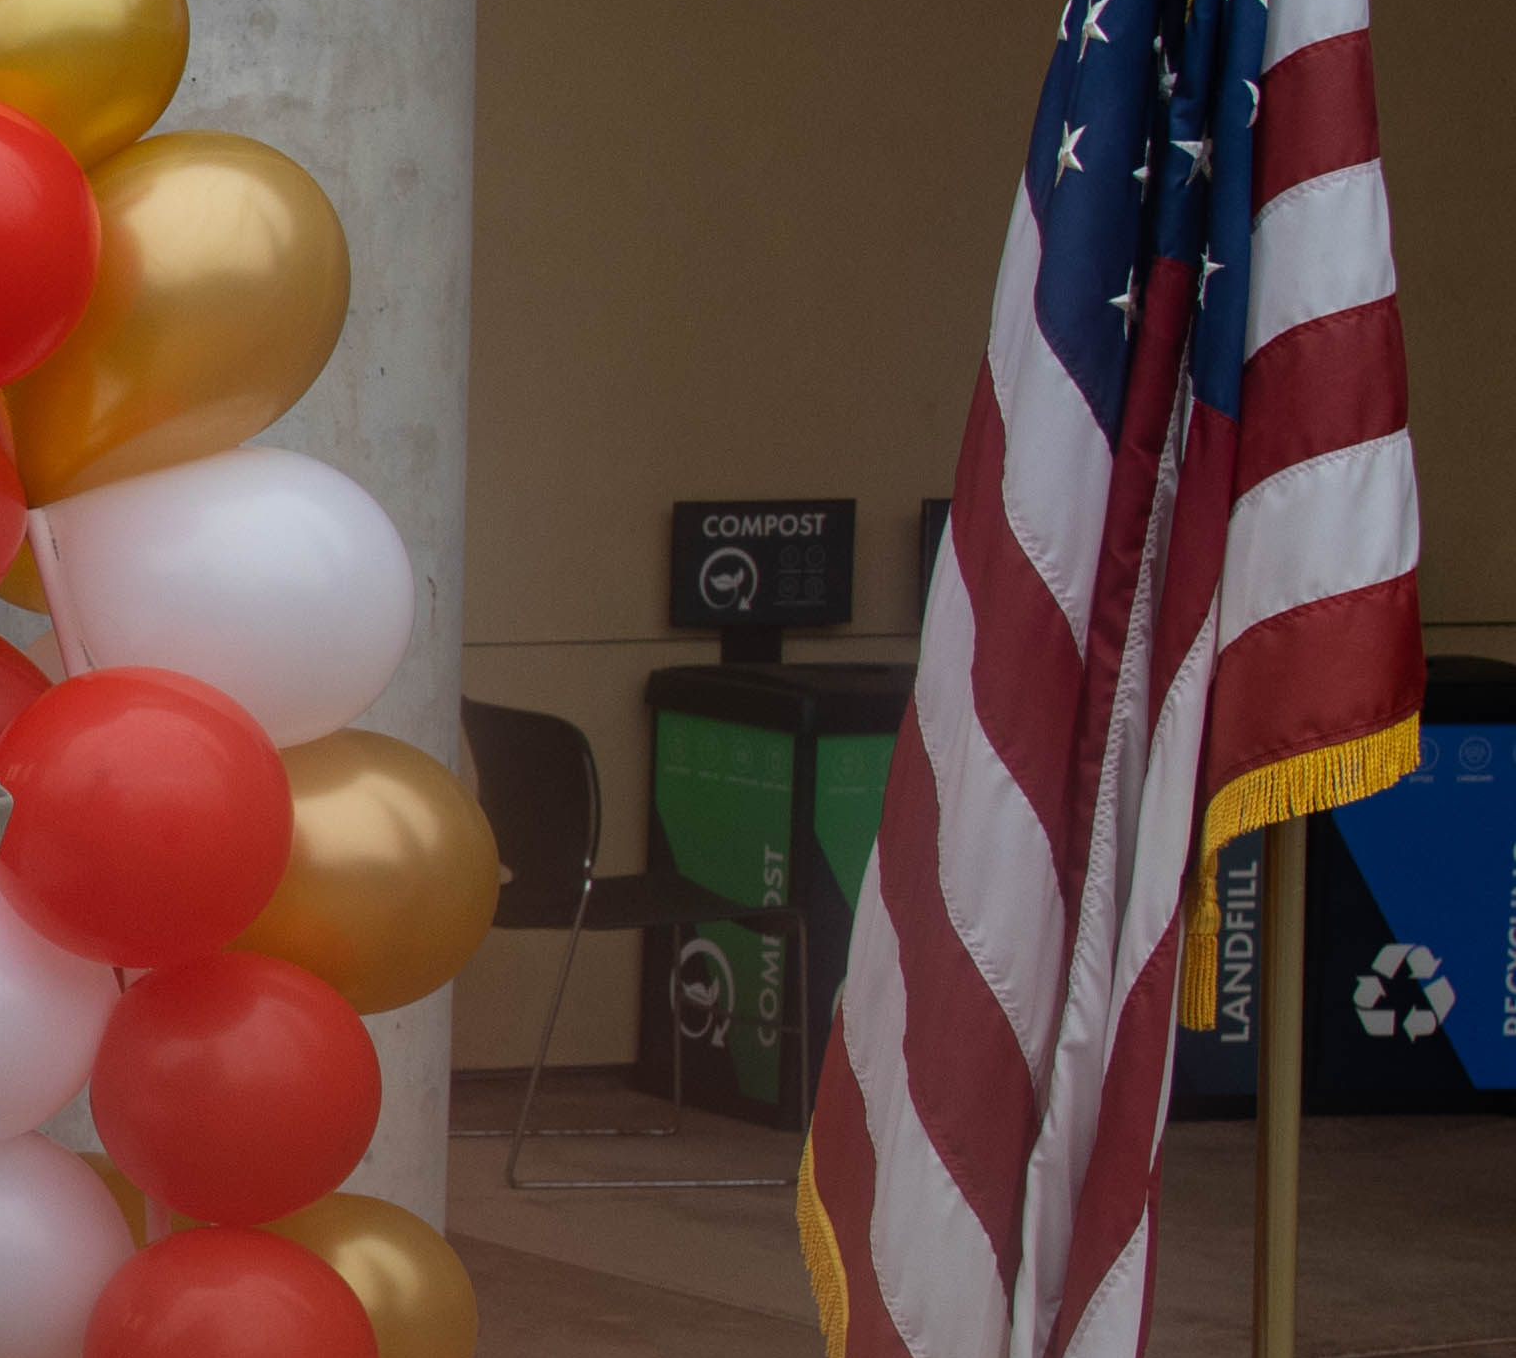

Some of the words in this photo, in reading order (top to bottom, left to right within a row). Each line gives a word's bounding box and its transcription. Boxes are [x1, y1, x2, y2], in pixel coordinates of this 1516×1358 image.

[702, 513, 828, 538] COMPOST
[756, 843, 786, 1049] COMOST
[1220, 860, 1259, 1043] LANDFILL
